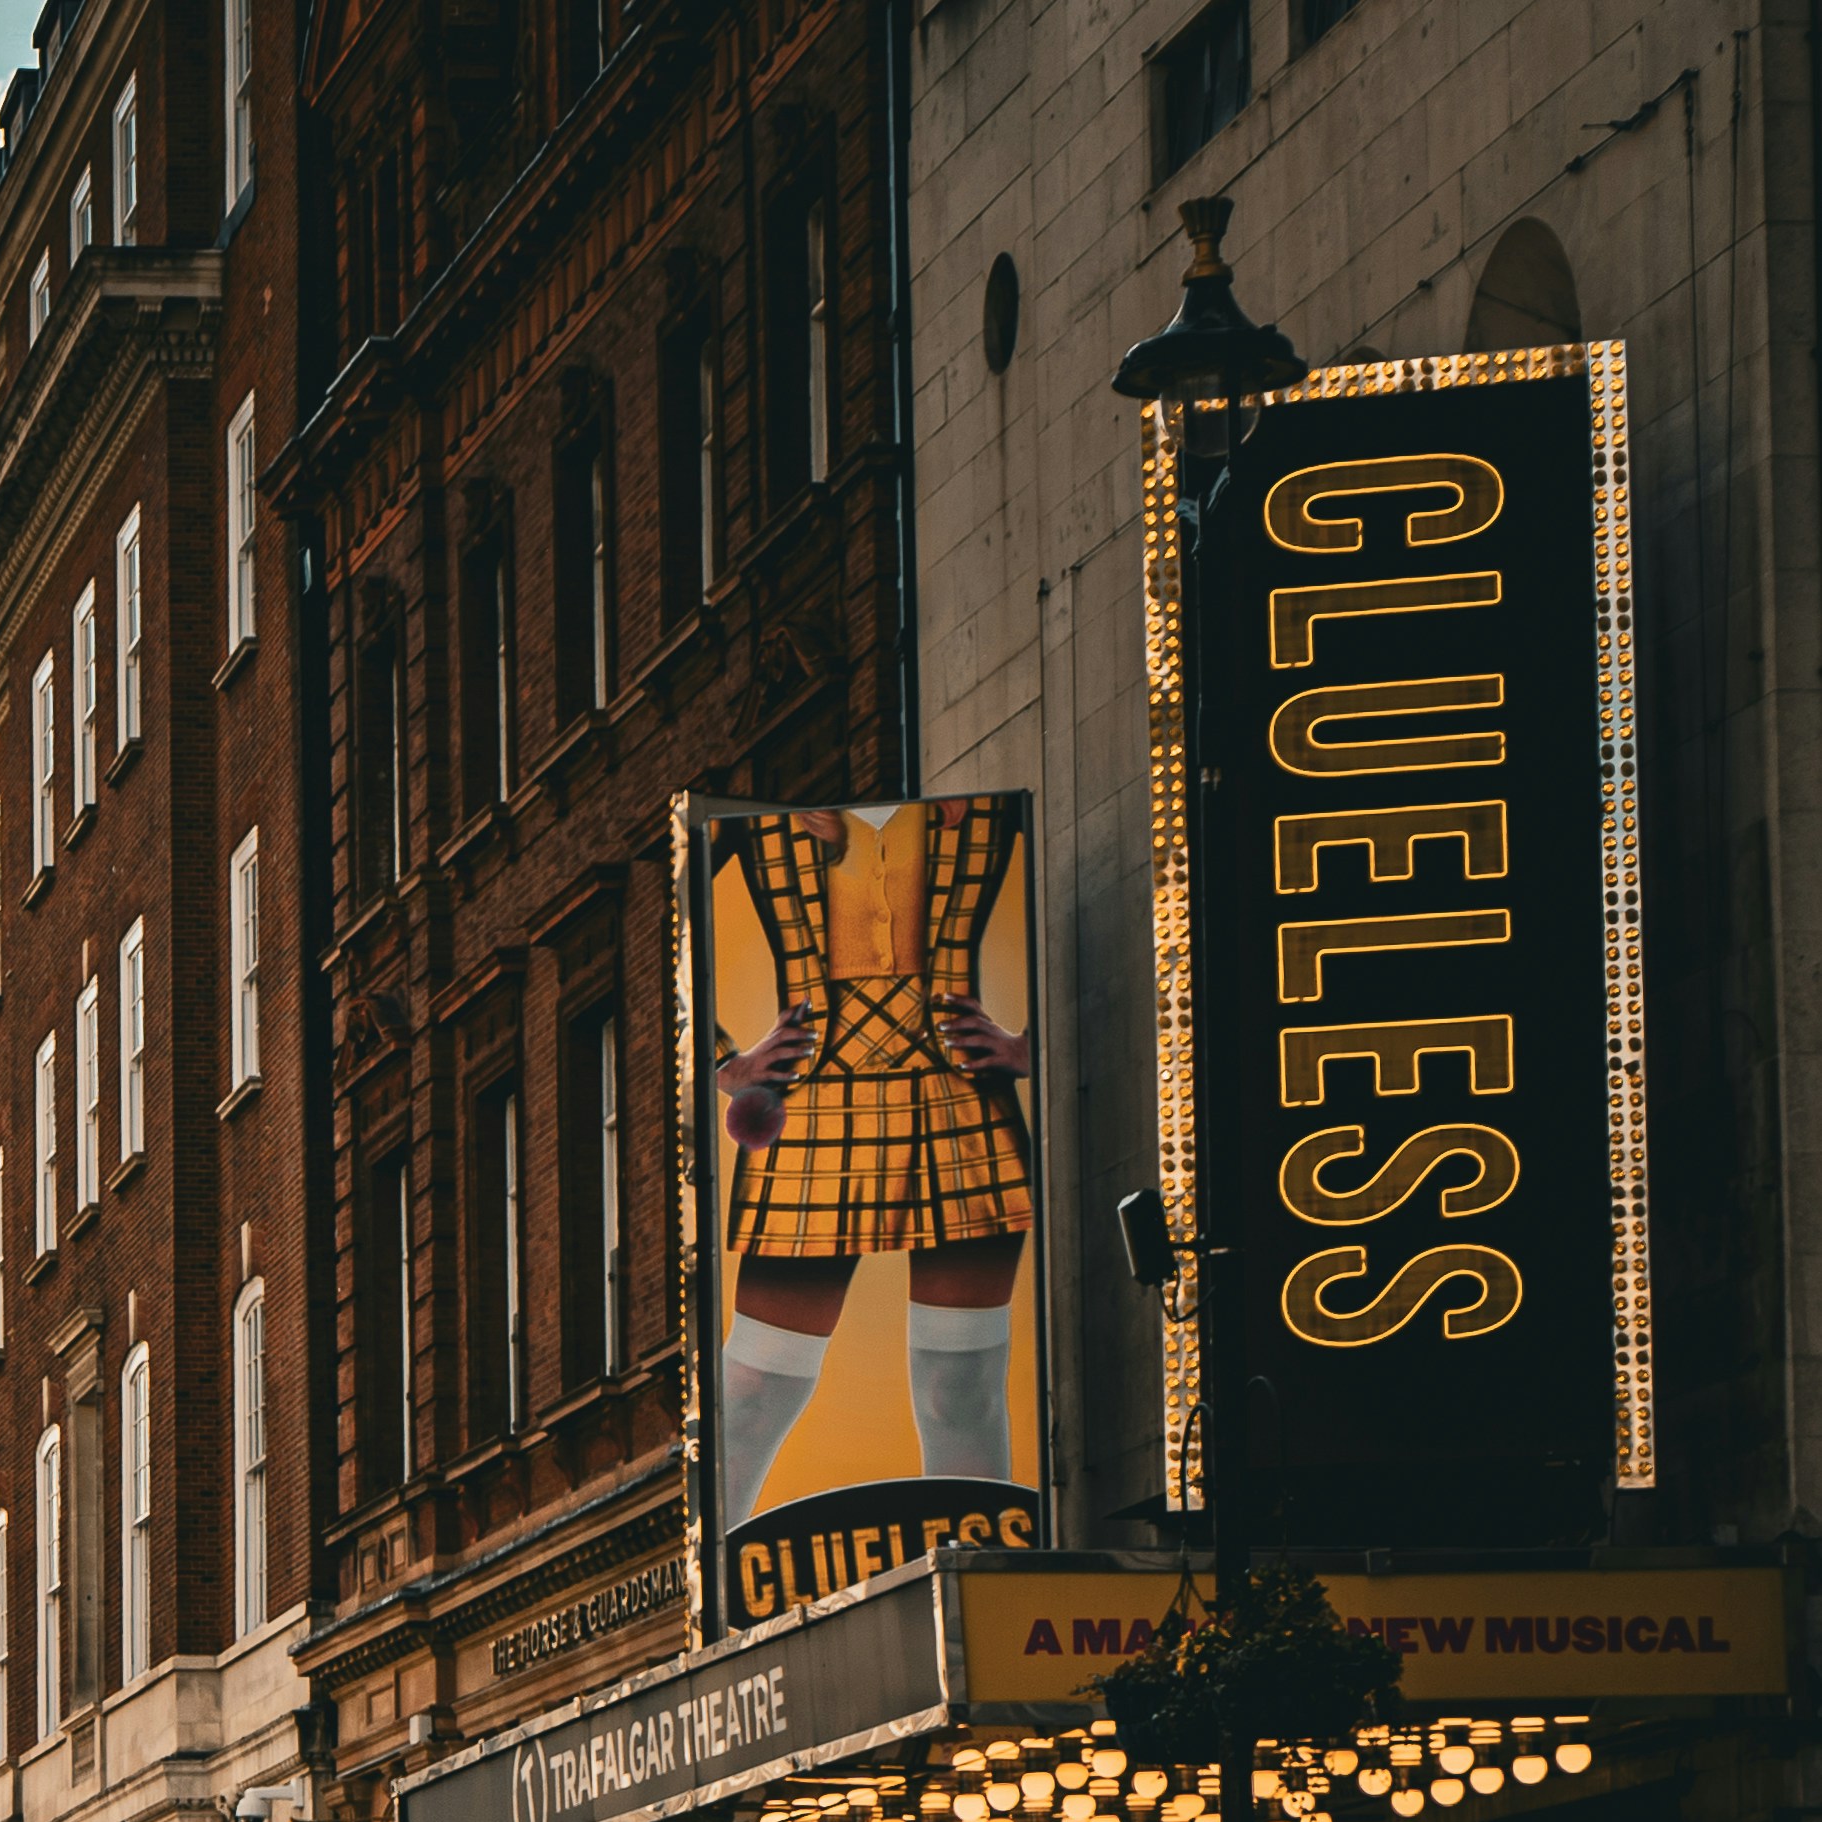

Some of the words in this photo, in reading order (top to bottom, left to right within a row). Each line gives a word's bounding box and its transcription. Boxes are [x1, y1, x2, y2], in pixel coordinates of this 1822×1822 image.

[1263, 453, 1523, 1348] CLUELESS
[488, 1634, 515, 1676] THE
[520, 1608, 568, 1663] HORSE
[573, 1603, 581, 1640] &
[587, 1556, 687, 1632] GUARDSMAN
[1024, 1618, 1063, 1655] A
[1485, 1615, 1731, 1654] MUSICAL
[550, 1710, 676, 1813] TRAFALGAR
[678, 1666, 787, 1766] THEATRE
